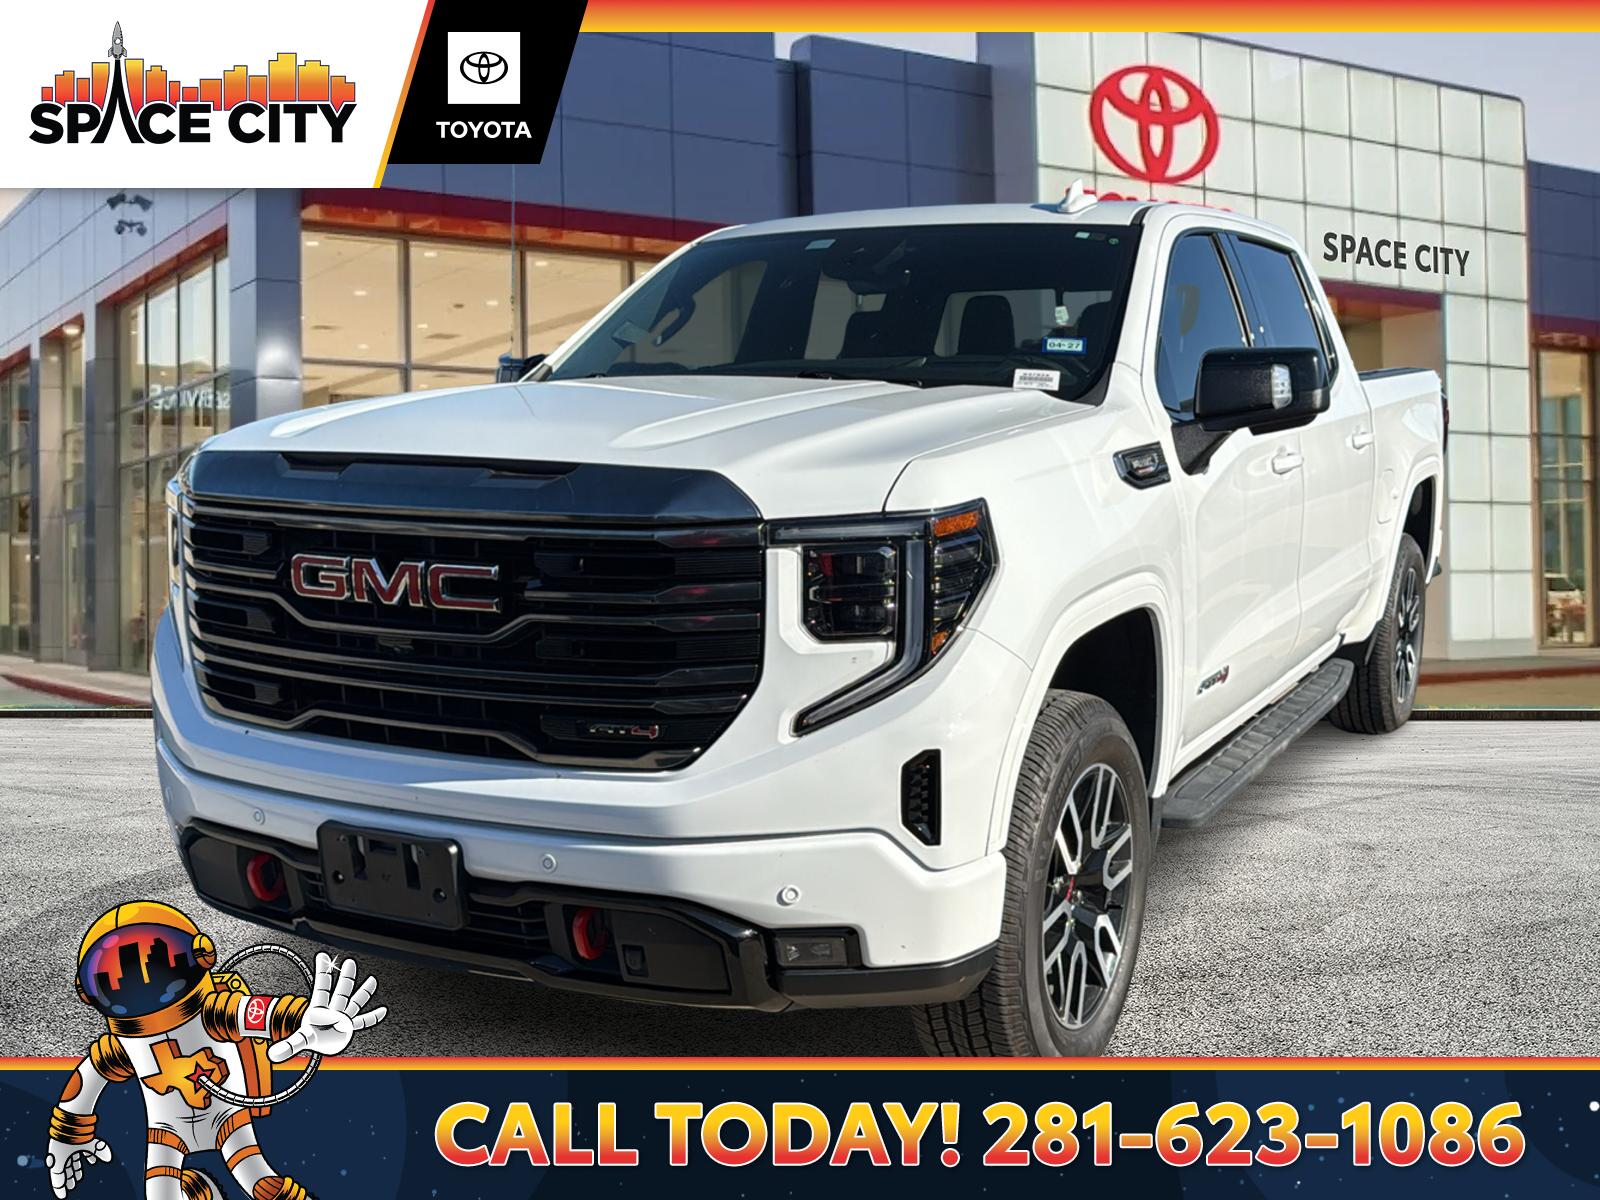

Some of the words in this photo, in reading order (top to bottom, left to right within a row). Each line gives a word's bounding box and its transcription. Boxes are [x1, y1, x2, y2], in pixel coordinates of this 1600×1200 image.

[1323, 232, 1408, 270] SPACE
[1415, 244, 1470, 277] CITY
[291, 553, 500, 613] GMC
